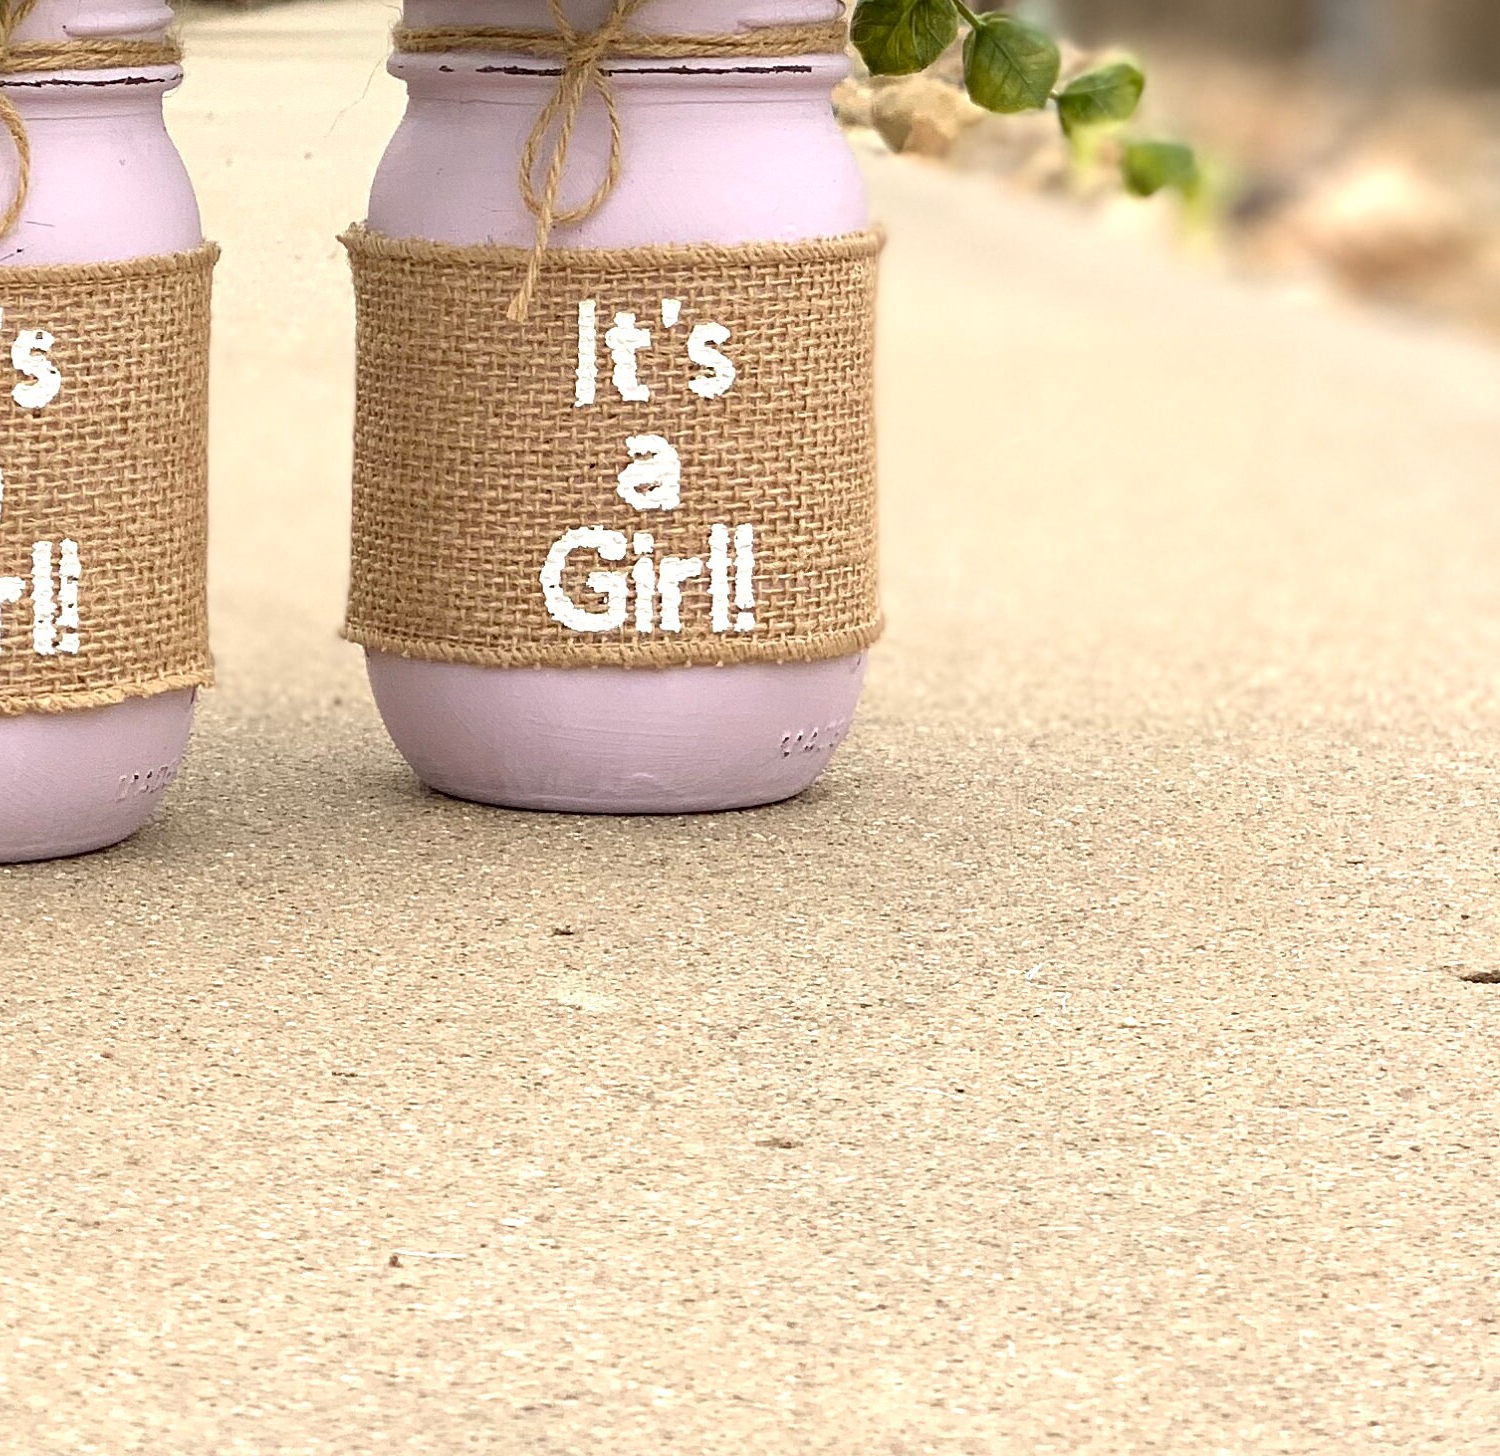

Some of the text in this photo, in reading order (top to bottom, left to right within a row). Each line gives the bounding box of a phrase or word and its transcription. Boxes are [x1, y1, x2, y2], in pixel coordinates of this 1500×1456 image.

[573, 297, 736, 408] It's
[616, 434, 682, 511] a
[538, 523, 756, 634] Girl!
